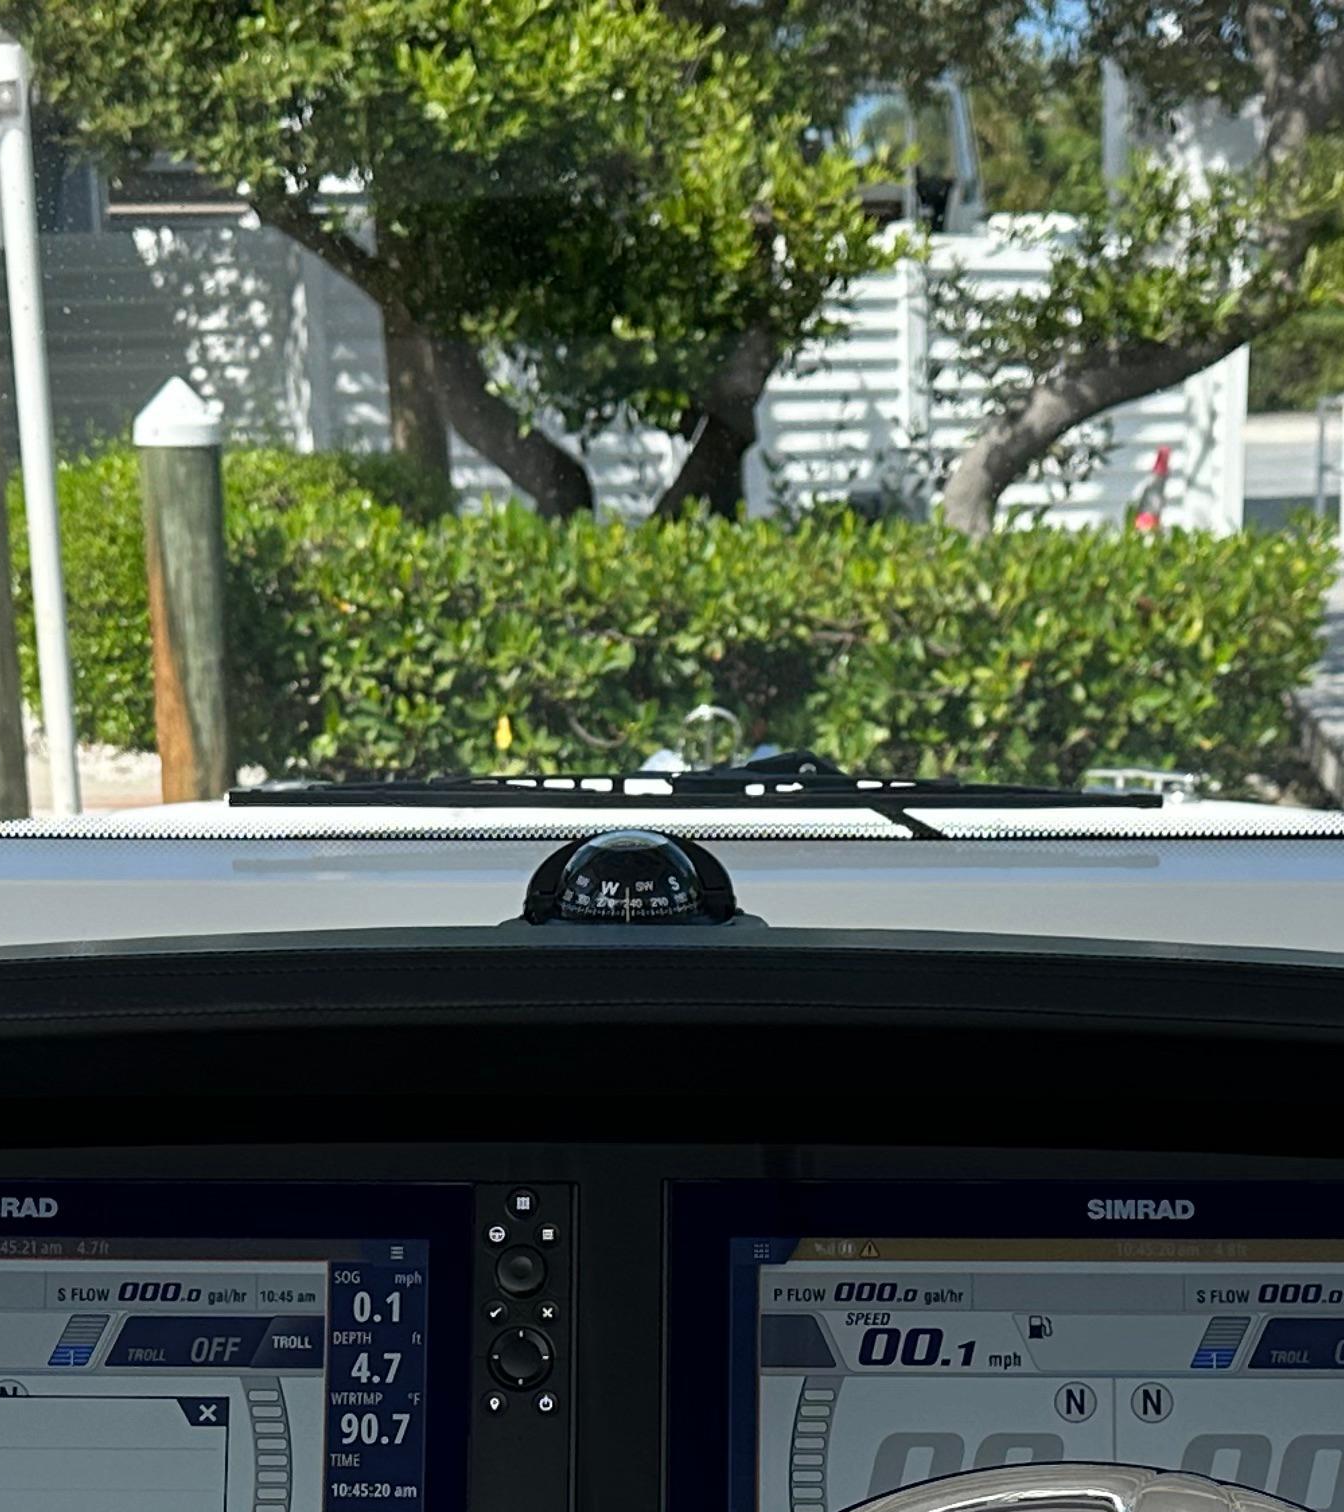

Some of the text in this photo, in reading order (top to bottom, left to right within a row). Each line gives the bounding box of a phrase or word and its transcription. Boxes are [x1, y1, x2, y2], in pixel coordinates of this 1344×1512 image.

[601, 881, 620, 896] W
[668, 876, 680, 891] S
[1087, 1199, 1195, 1220] SIMRAD
[38, 1243, 61, 1255] am
[334, 1270, 422, 1289] SOG mph
[58, 1281, 247, 1305] S FLOW 000.0 gal/hr
[260, 1289, 316, 1304] 10:45 am
[774, 1281, 964, 1305] P FLOW 000.0 gal/hr
[1196, 1290, 1205, 1303] S
[1210, 1290, 1250, 1303] FLOW
[1258, 1283, 1343, 1304] 000.0
[353, 1291, 402, 1323] 0.1
[845, 1312, 891, 1326] SPEED
[272, 1335, 312, 1349] TROLL
[333, 1330, 422, 1345] DEPTH ft
[127, 1336, 241, 1362] TROLL OFF
[858, 1327, 1022, 1370] 00.1 mph
[1270, 1349, 1310, 1363] TROLL
[351, 1352, 402, 1384] 4.7
[331, 1391, 383, 1406] WTRTMP
[1065, 1390, 1085, 1415] N
[1142, 1390, 1162, 1415] N
[341, 1413, 410, 1444] 90.7
[330, 1453, 360, 1467] TIME
[331, 1483, 417, 1498] 10:45:20 am
